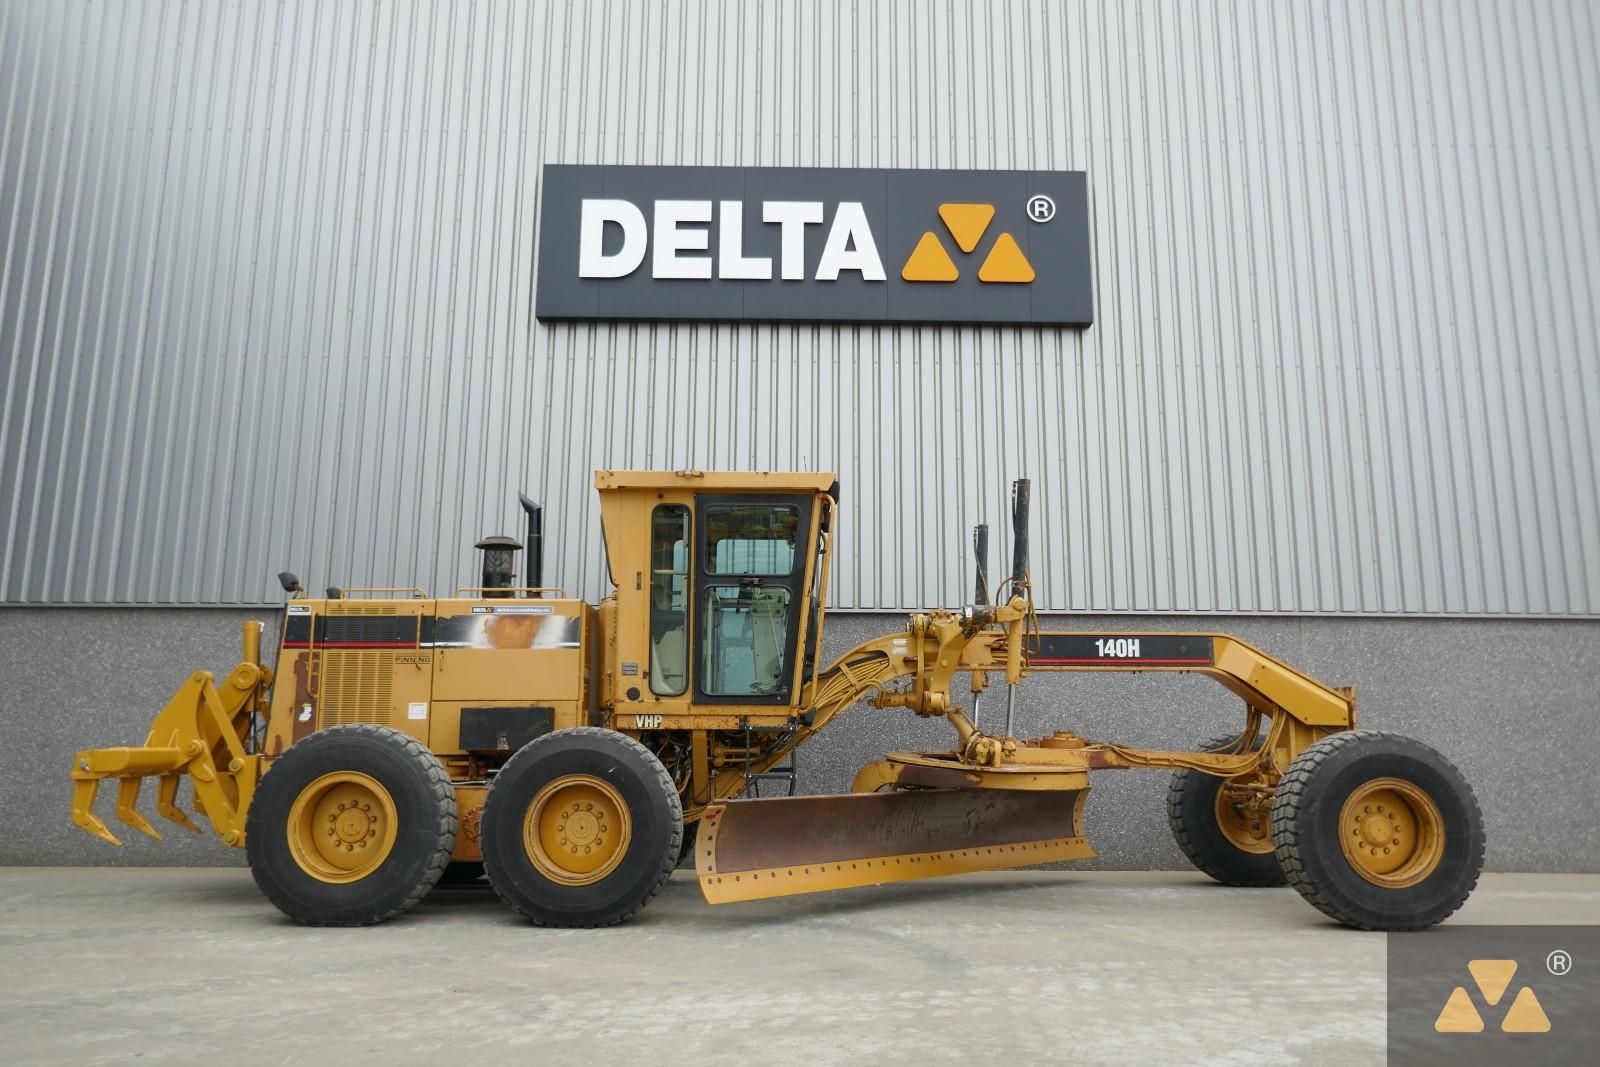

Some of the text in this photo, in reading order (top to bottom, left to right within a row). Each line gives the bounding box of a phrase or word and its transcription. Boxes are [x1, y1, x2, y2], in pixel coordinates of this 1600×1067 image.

[578, 199, 887, 281] DELTA
[1095, 638, 1140, 658] 140H
[635, 714, 663, 729] VHP
